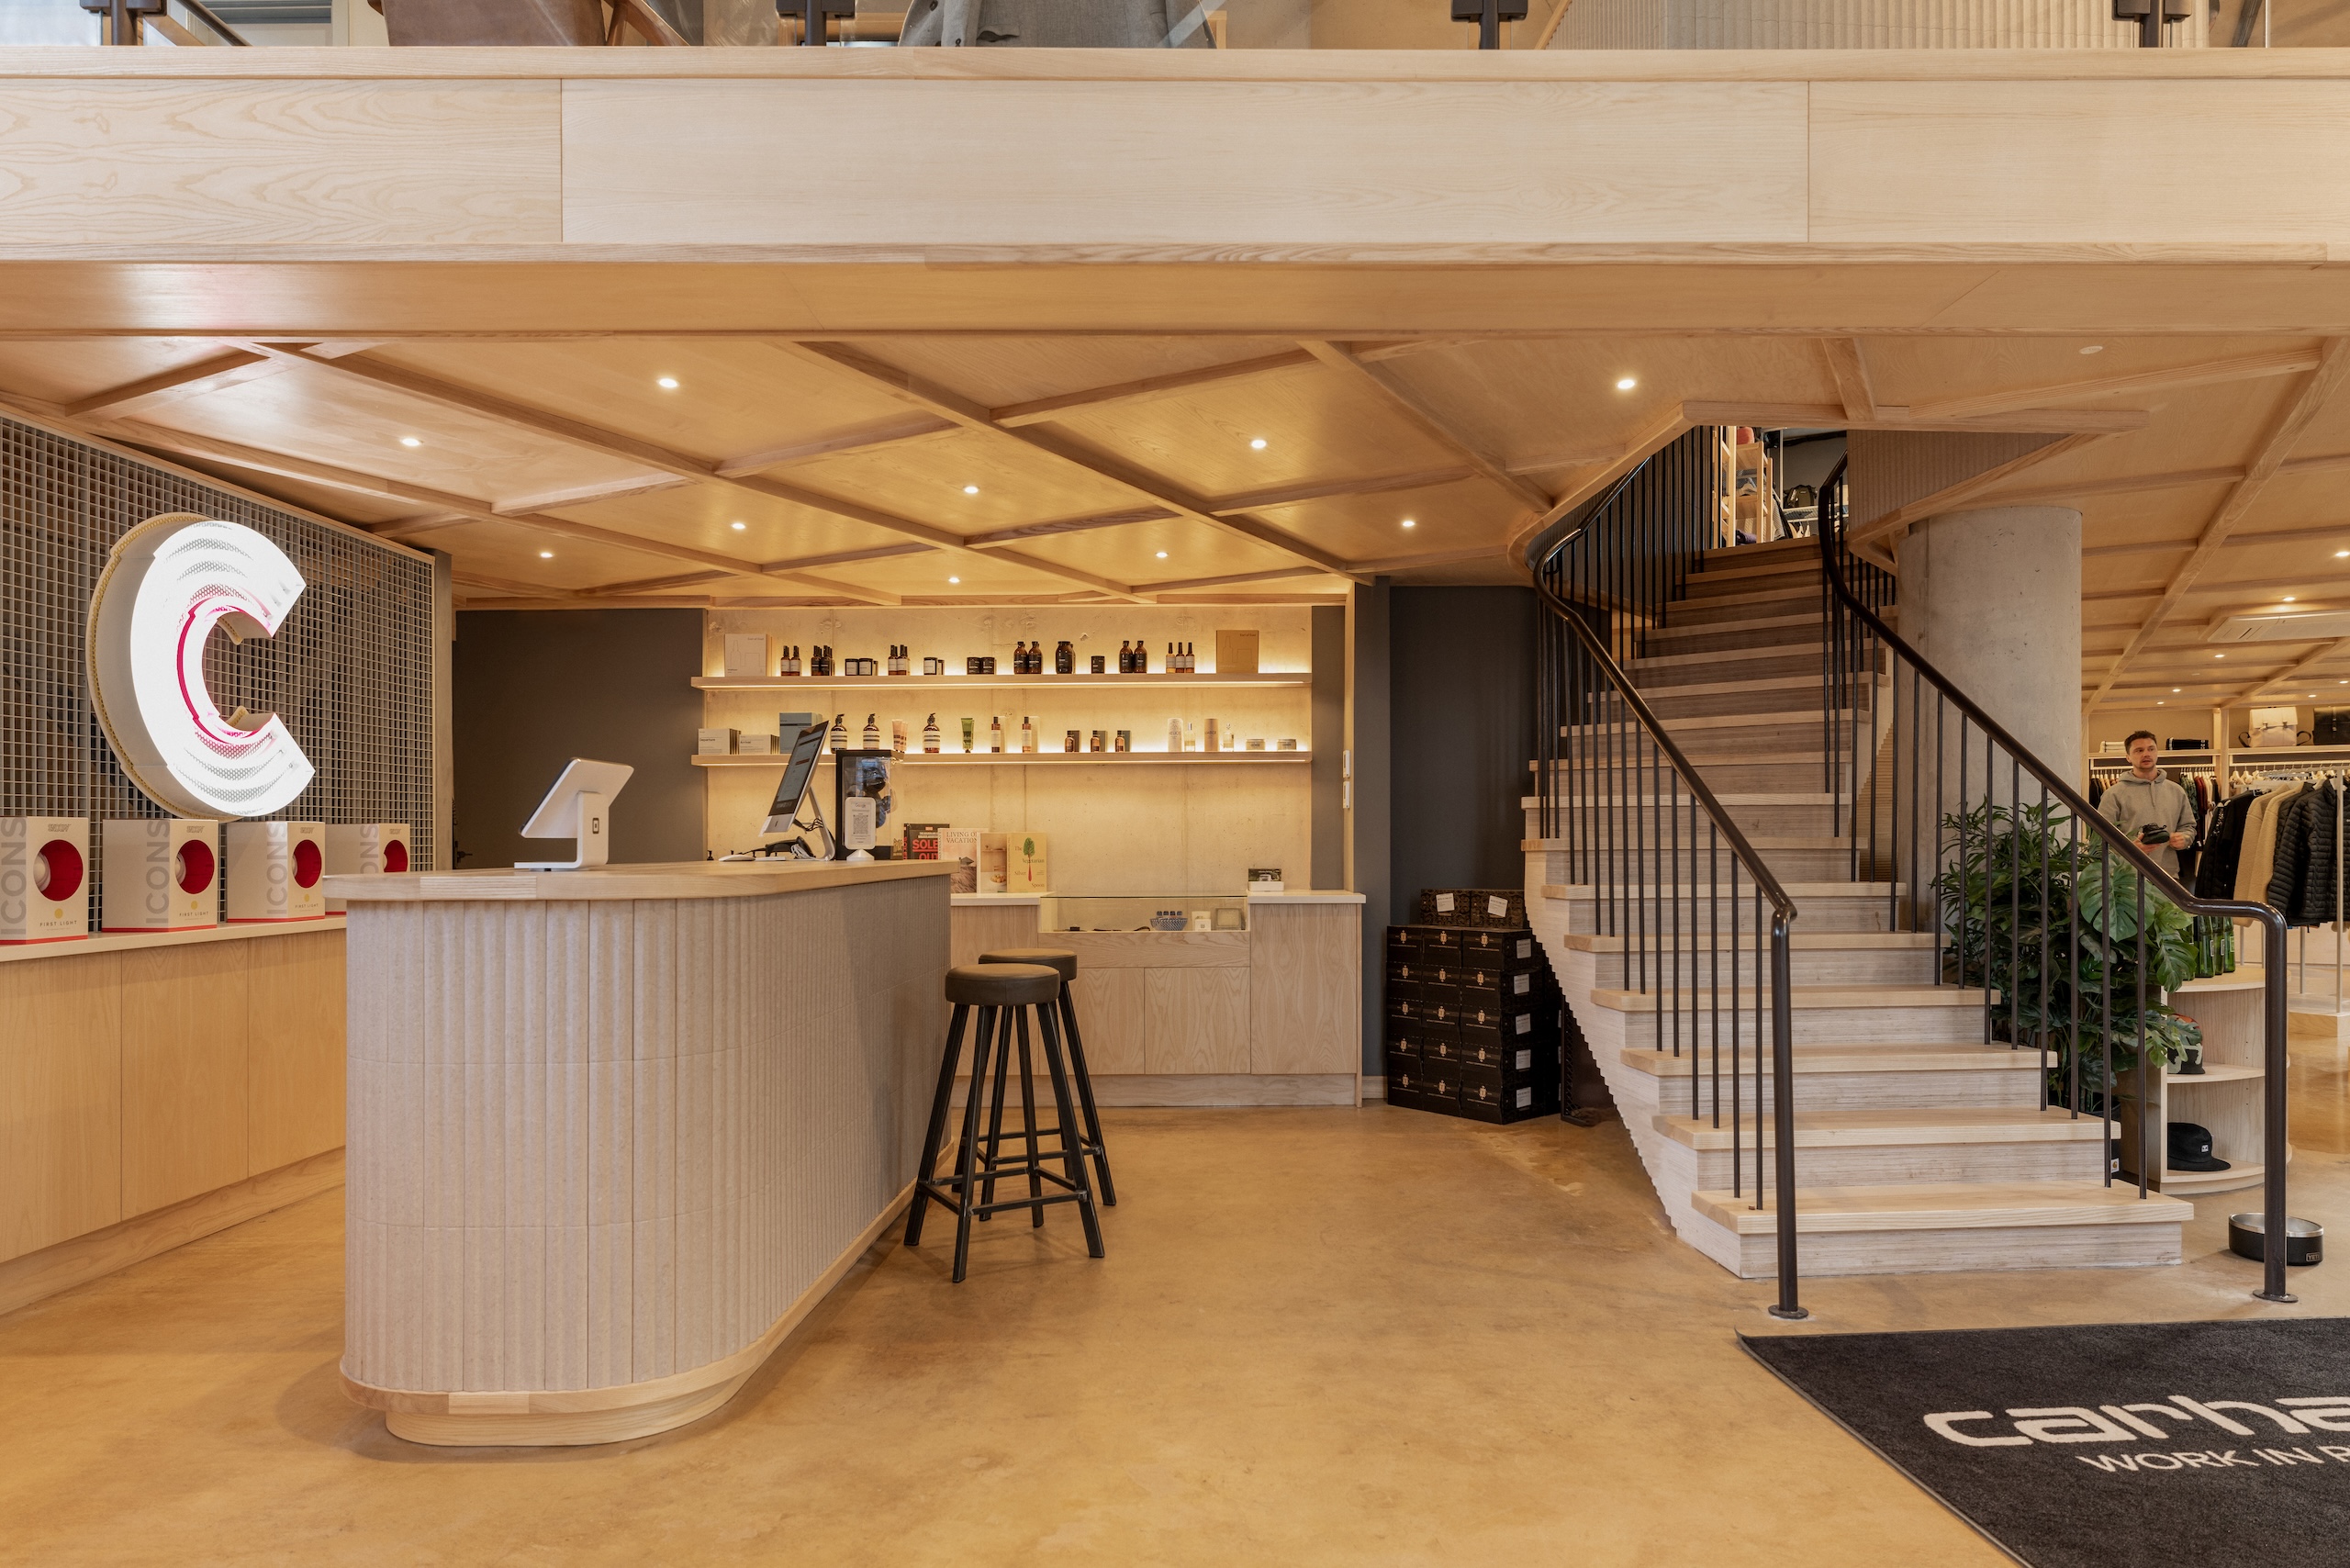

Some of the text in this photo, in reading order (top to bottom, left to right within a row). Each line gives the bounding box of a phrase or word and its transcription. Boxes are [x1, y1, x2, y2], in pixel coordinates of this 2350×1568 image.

[0, 816, 27, 935] ICONS
[146, 820, 170, 924] ICONS
[266, 823, 288, 914] ICONS
[2076, 1449, 2260, 1473] WORK
[2252, 1446, 2324, 1466] IN
